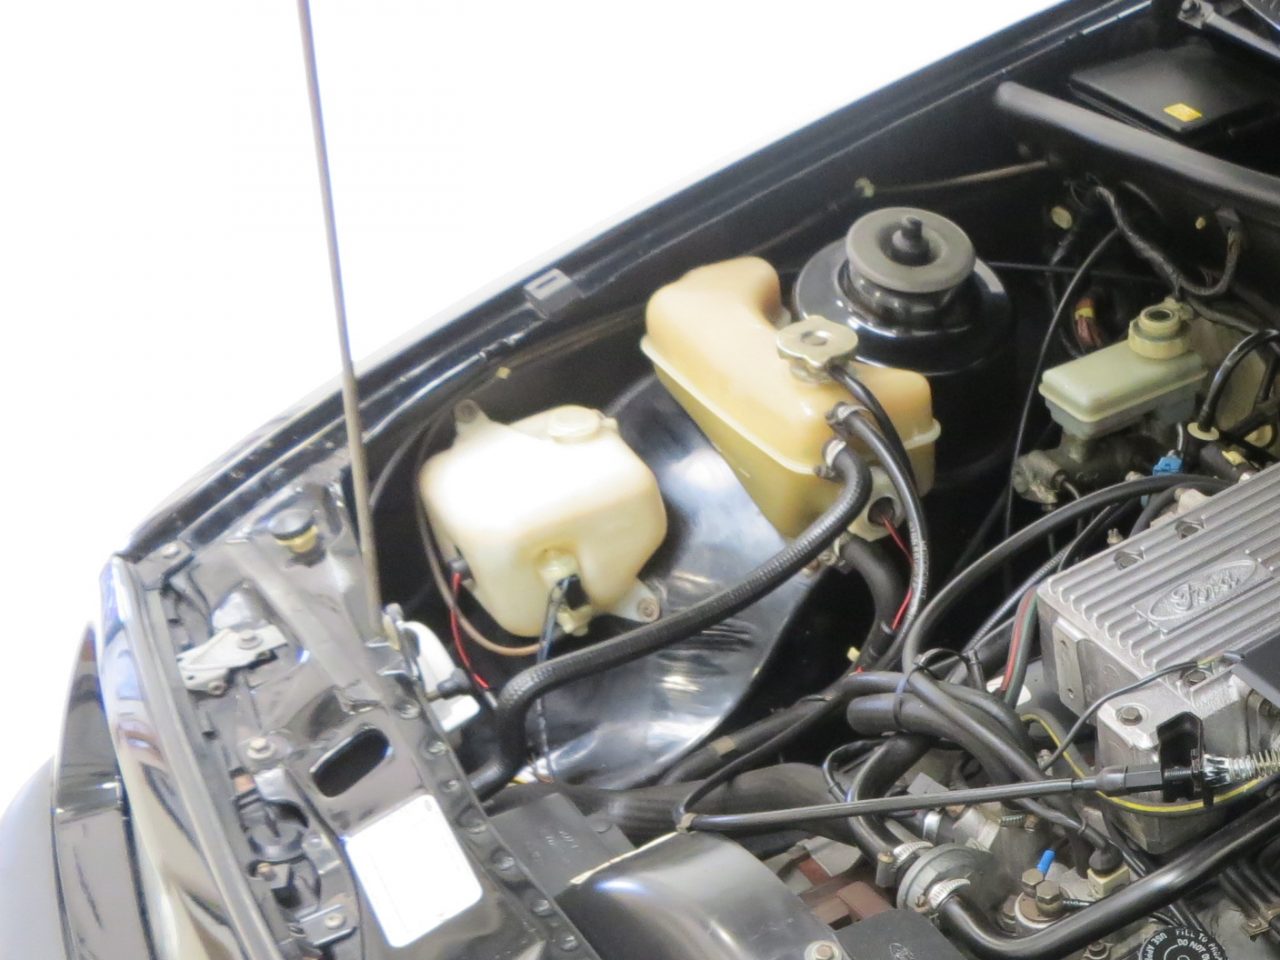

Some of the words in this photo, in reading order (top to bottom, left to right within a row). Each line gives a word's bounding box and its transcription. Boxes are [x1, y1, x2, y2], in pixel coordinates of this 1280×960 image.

[1176, 929, 1195, 938] FILL
[1198, 933, 1208, 942] TO
[1177, 938, 1188, 946] DO
[1189, 941, 1206, 953] NOT
